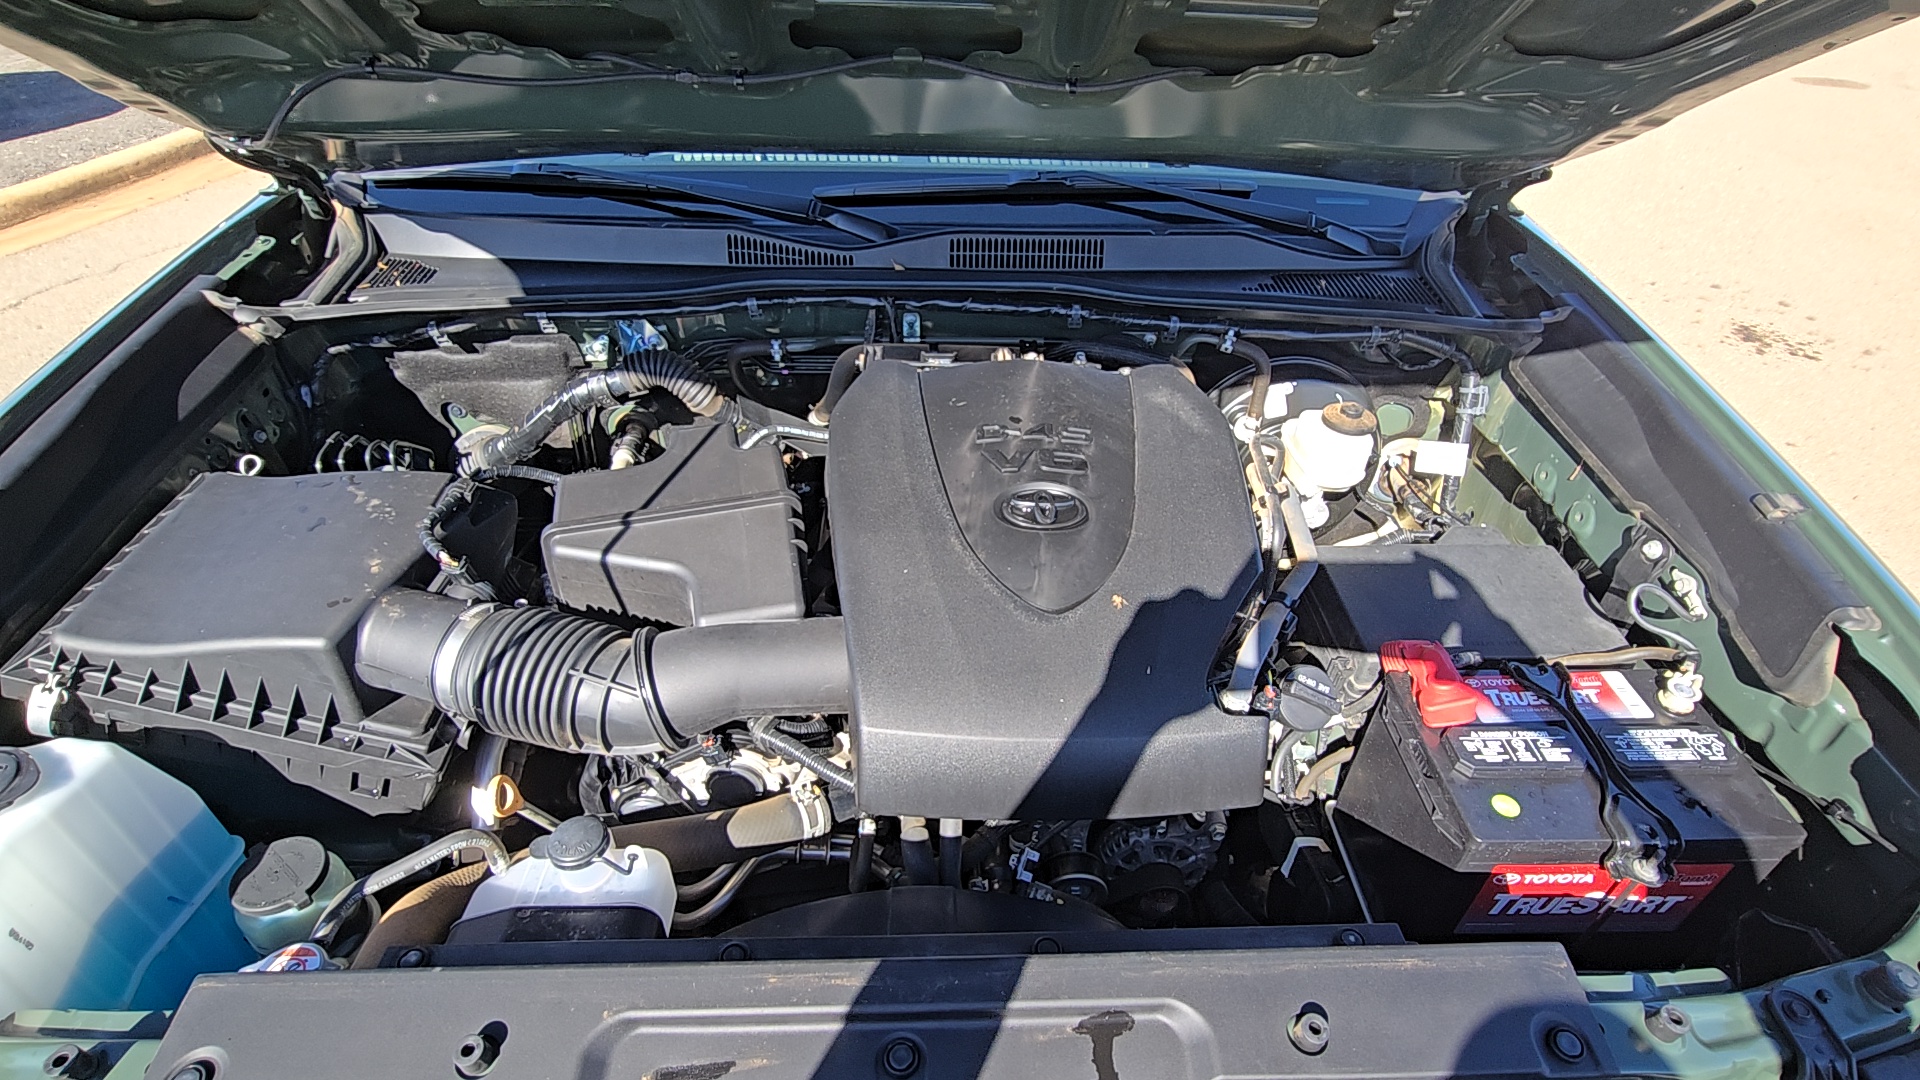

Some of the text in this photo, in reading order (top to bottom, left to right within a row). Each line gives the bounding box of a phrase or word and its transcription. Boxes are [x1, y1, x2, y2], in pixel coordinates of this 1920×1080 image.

[980, 448, 1091, 474] V6
[1297, 674, 1330, 694] SAE 0W-20
[1482, 678, 1519, 687] TOYOT
[1523, 873, 1594, 884] TOYOTA
